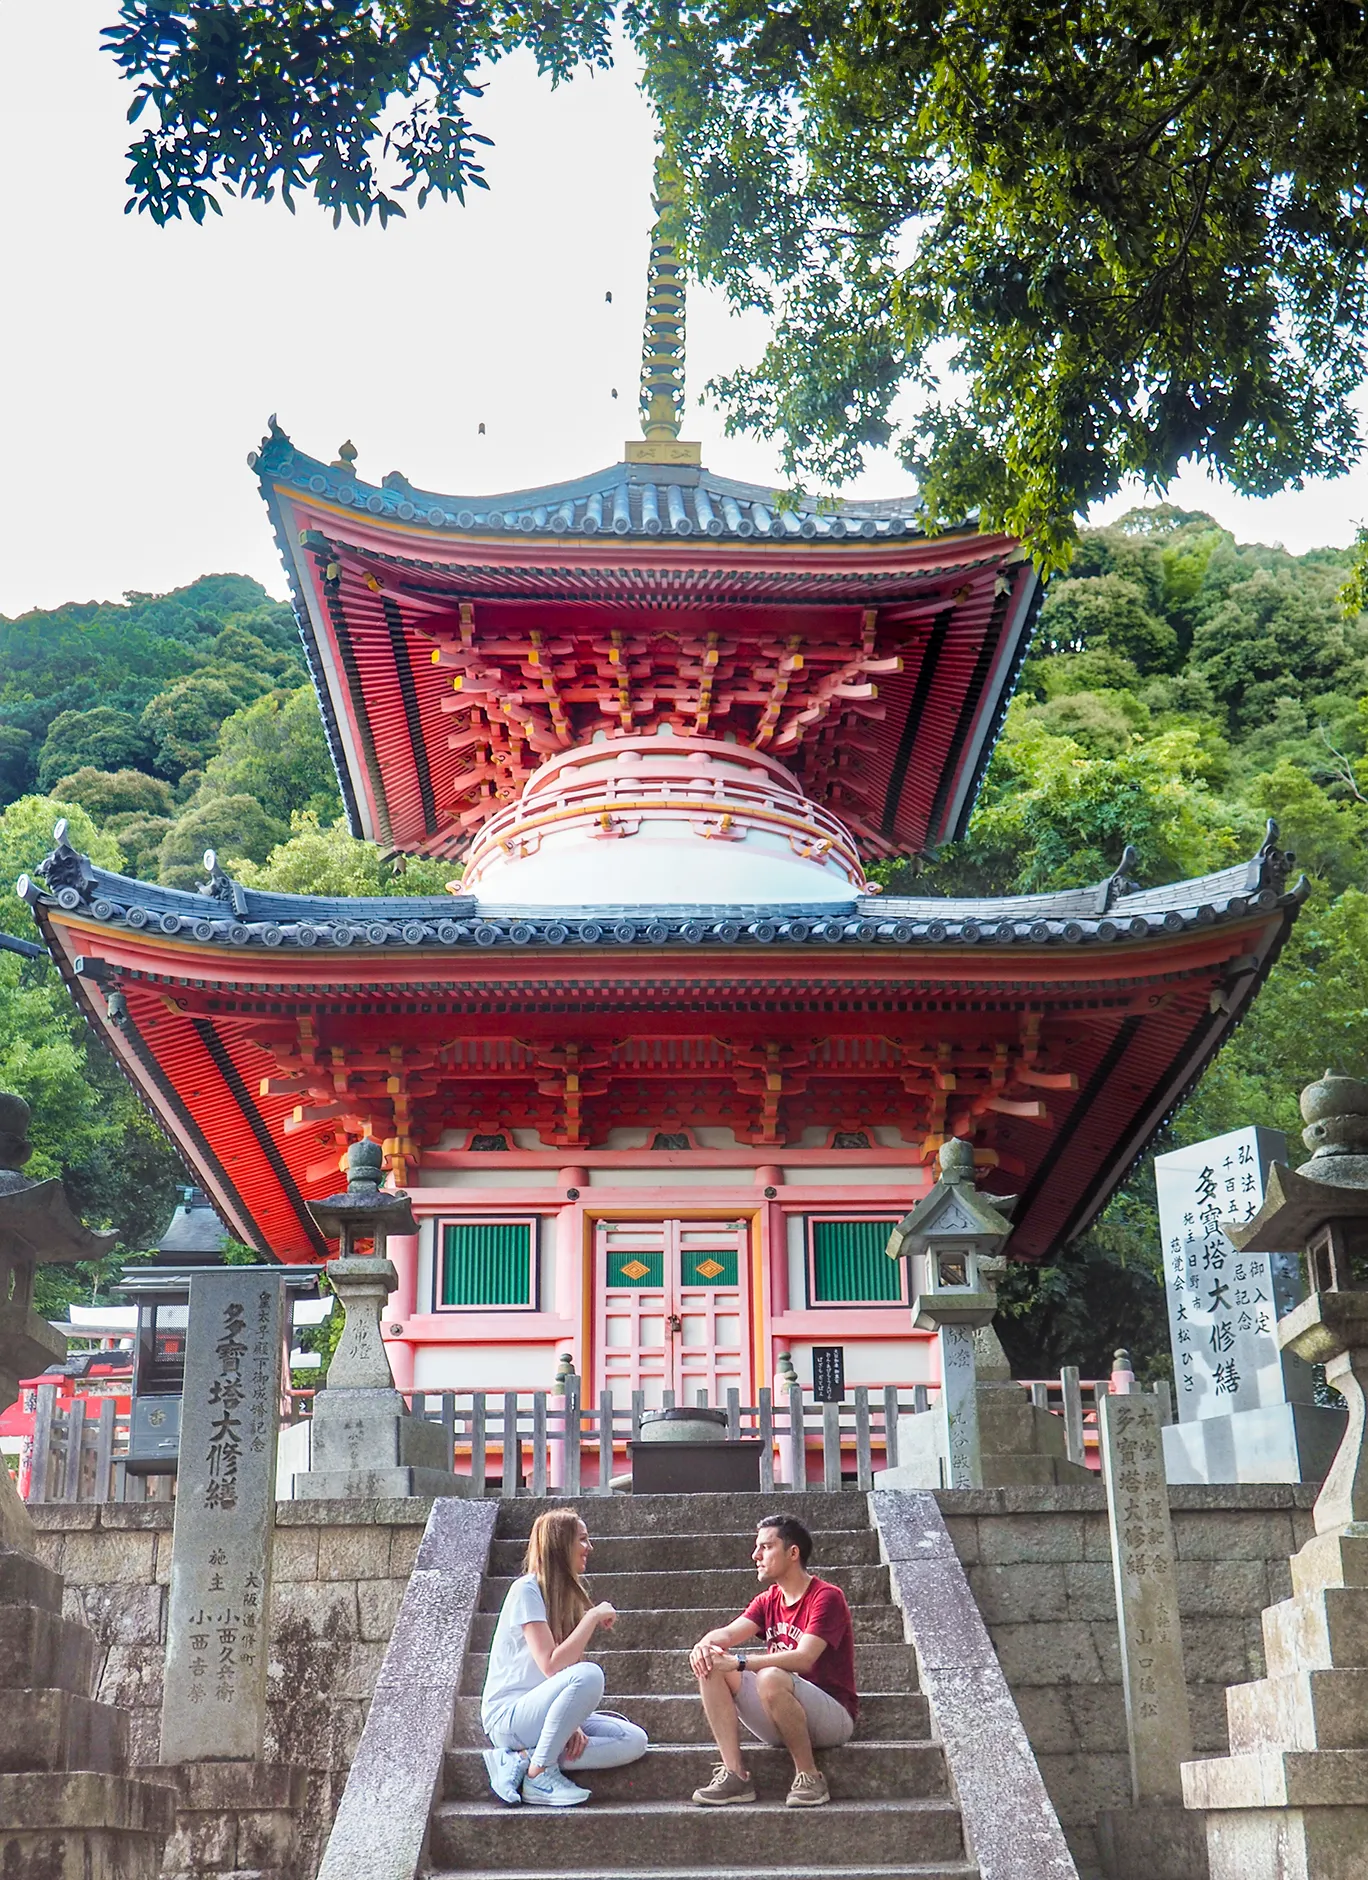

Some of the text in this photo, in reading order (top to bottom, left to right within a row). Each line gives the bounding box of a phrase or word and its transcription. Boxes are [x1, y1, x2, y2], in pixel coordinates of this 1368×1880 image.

[1222, 1156, 1252, 1332] 千百五忌記念
[1238, 1144, 1270, 1335] 弘法大御入定
